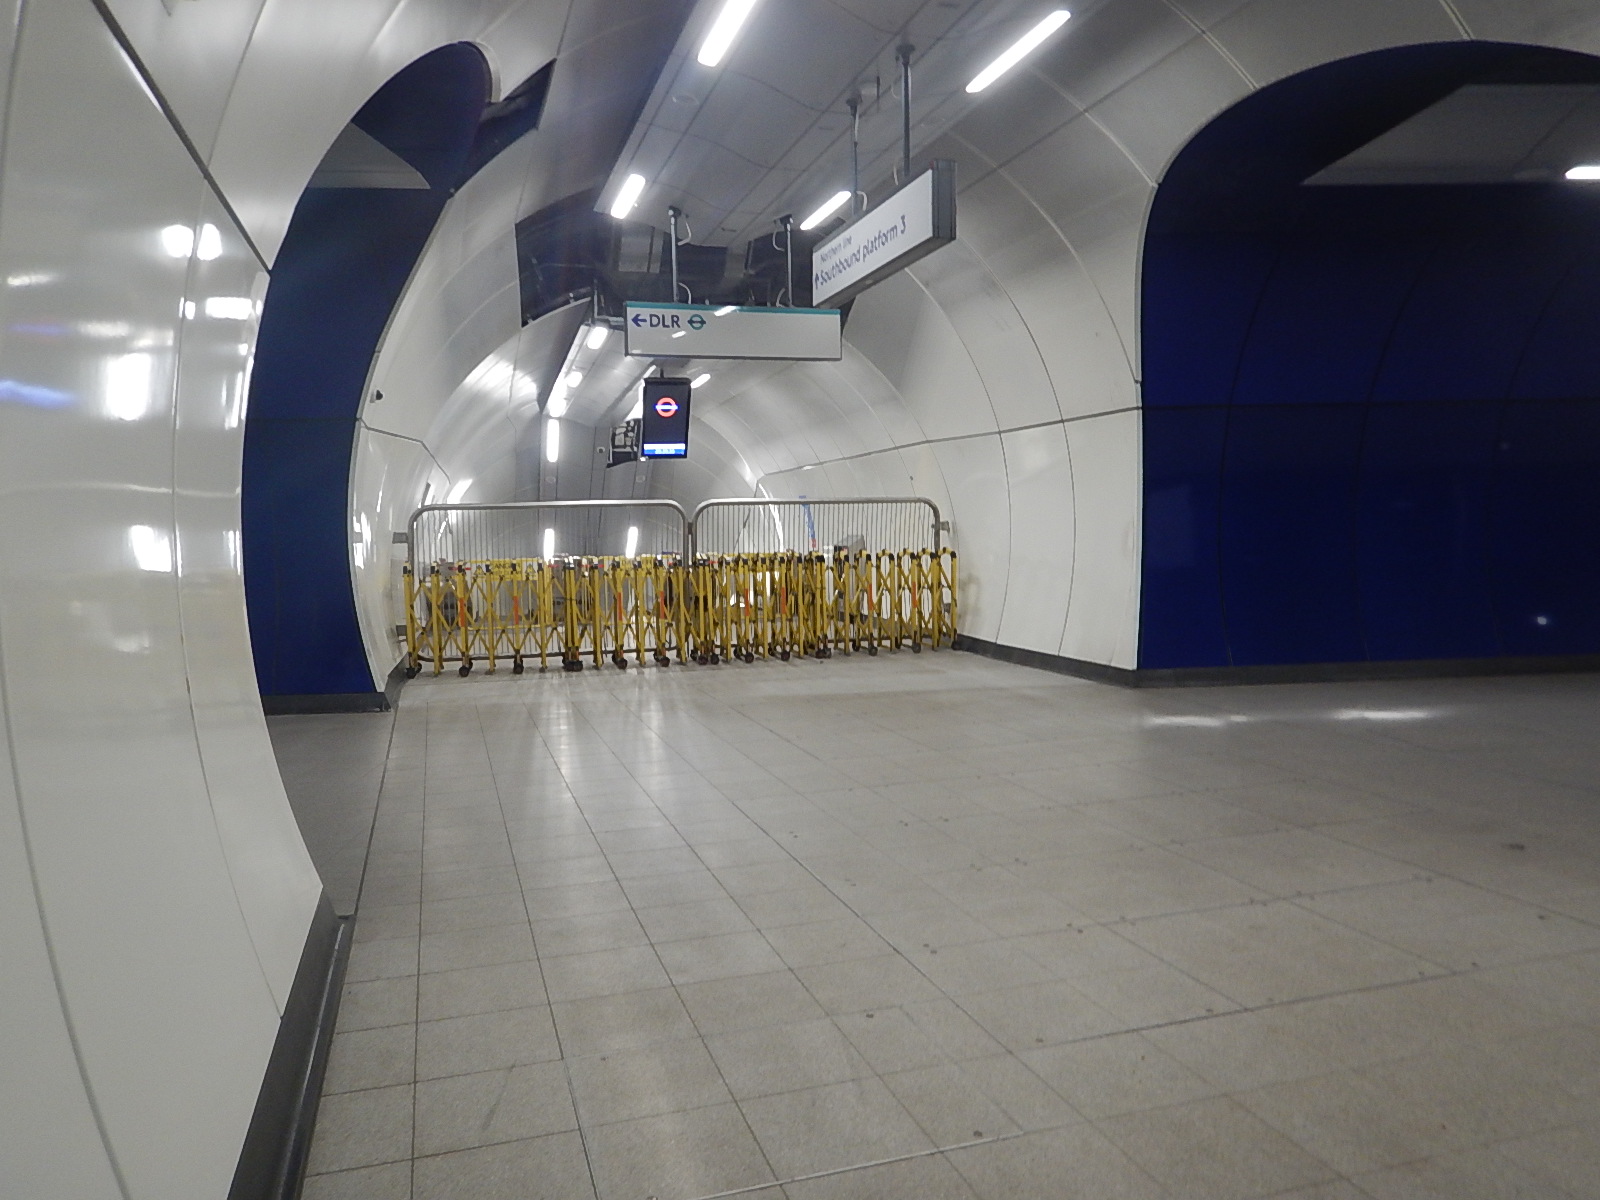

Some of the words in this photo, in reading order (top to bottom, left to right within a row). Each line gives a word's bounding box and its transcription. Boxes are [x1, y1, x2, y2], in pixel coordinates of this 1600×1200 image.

[820, 244, 861, 286] Southbound
[862, 224, 898, 263] platform
[900, 214, 906, 234] 3
[649, 314, 681, 328] DLR
